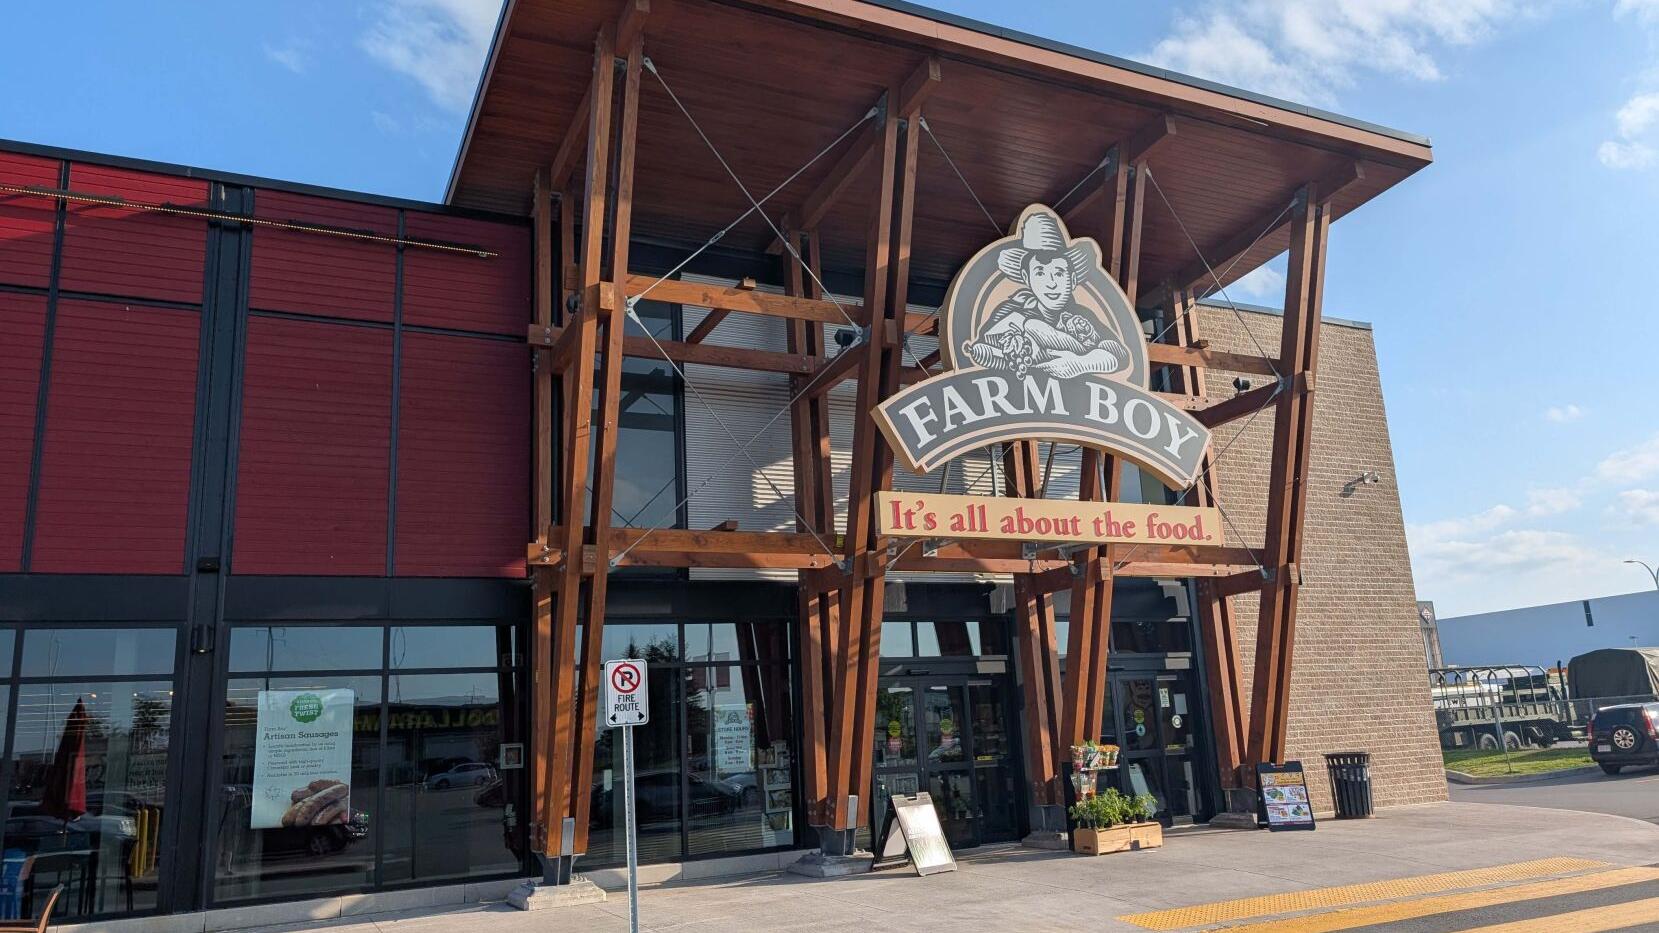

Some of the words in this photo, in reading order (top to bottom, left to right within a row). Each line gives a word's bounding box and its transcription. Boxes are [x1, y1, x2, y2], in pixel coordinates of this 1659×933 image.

[898, 375, 1070, 449] FARM
[1084, 382, 1199, 459] BOY
[889, 500, 937, 531] It's
[950, 504, 989, 533] all
[1000, 507, 1081, 536] about
[1092, 510, 1137, 538] the
[1147, 513, 1212, 541] food.
[617, 694, 635, 703] FIRE
[614, 703, 640, 712] ROUTE
[298, 731, 338, 739] Sausages
